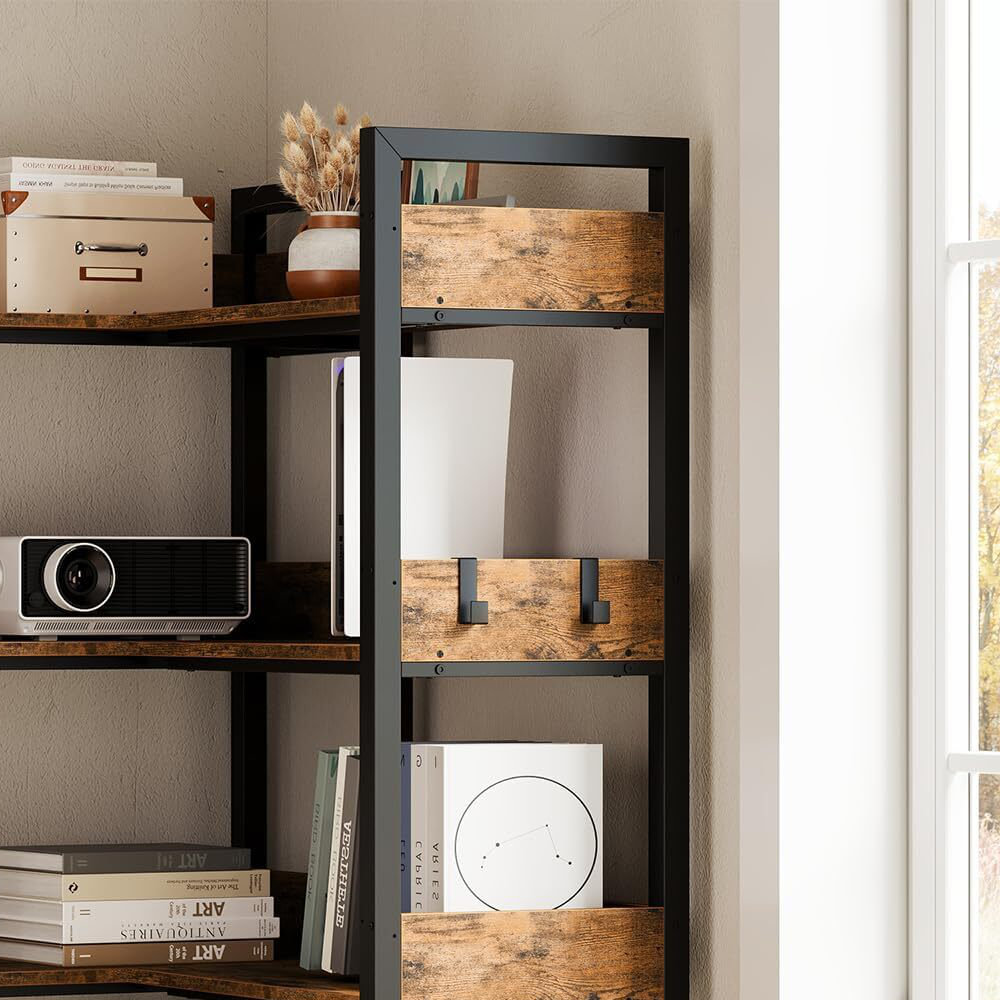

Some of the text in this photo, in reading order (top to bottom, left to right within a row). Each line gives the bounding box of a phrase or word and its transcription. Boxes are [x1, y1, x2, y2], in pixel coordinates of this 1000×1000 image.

[192, 902, 225, 917] ART
[120, 926, 226, 940] ANTIQUAIRES
[192, 945, 225, 960] ART
